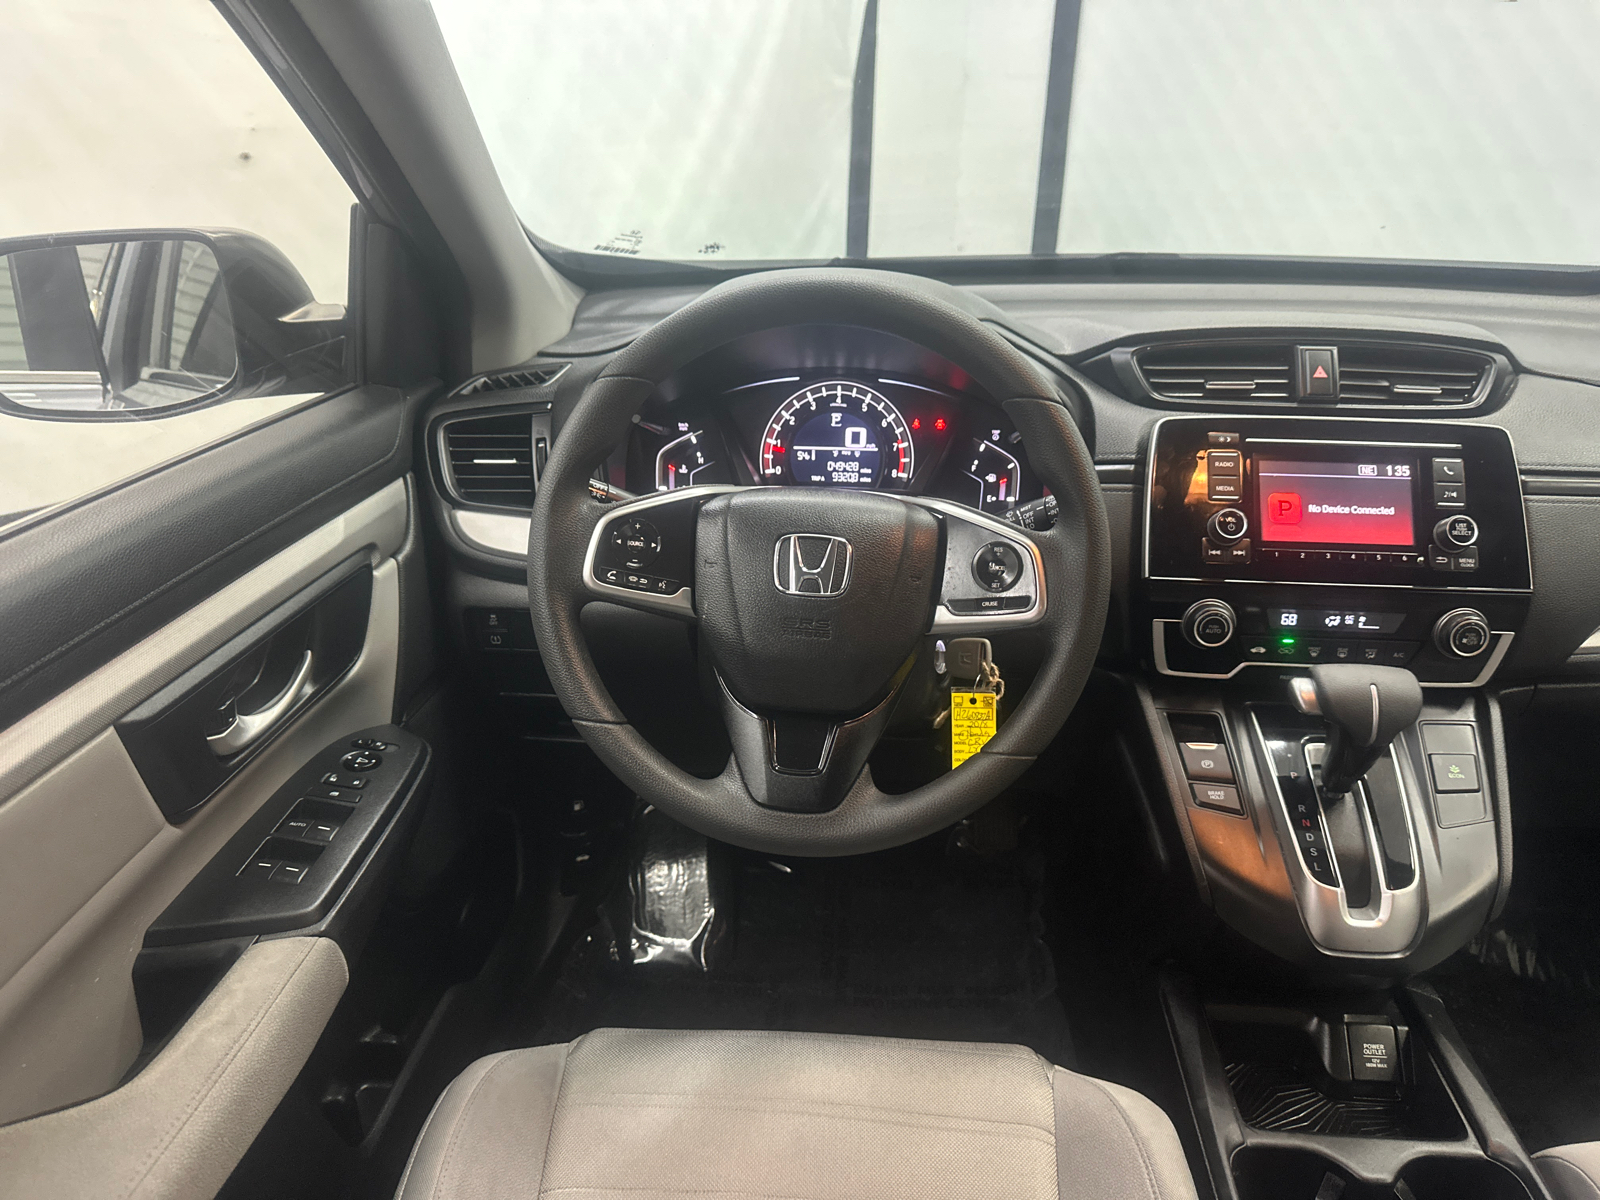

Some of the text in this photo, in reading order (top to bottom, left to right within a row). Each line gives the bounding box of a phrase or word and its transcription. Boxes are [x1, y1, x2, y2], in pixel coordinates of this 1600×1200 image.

[810, 402, 816, 410] 3
[862, 403, 868, 412] 5
[789, 416, 796, 426] 2
[881, 418, 888, 428] 6
[844, 427, 867, 448] 0
[892, 442, 898, 451] 7
[776, 466, 782, 474] 0
[891, 468, 898, 478] 8
[1308, 504, 1395, 515] No Device Connected
[1280, 613, 1298, 626] 68
[1298, 804, 1306, 813] R
[1302, 819, 1311, 827] N
[1306, 833, 1314, 841] D
[1310, 848, 1318, 856] S
[1314, 862, 1321, 871] L
